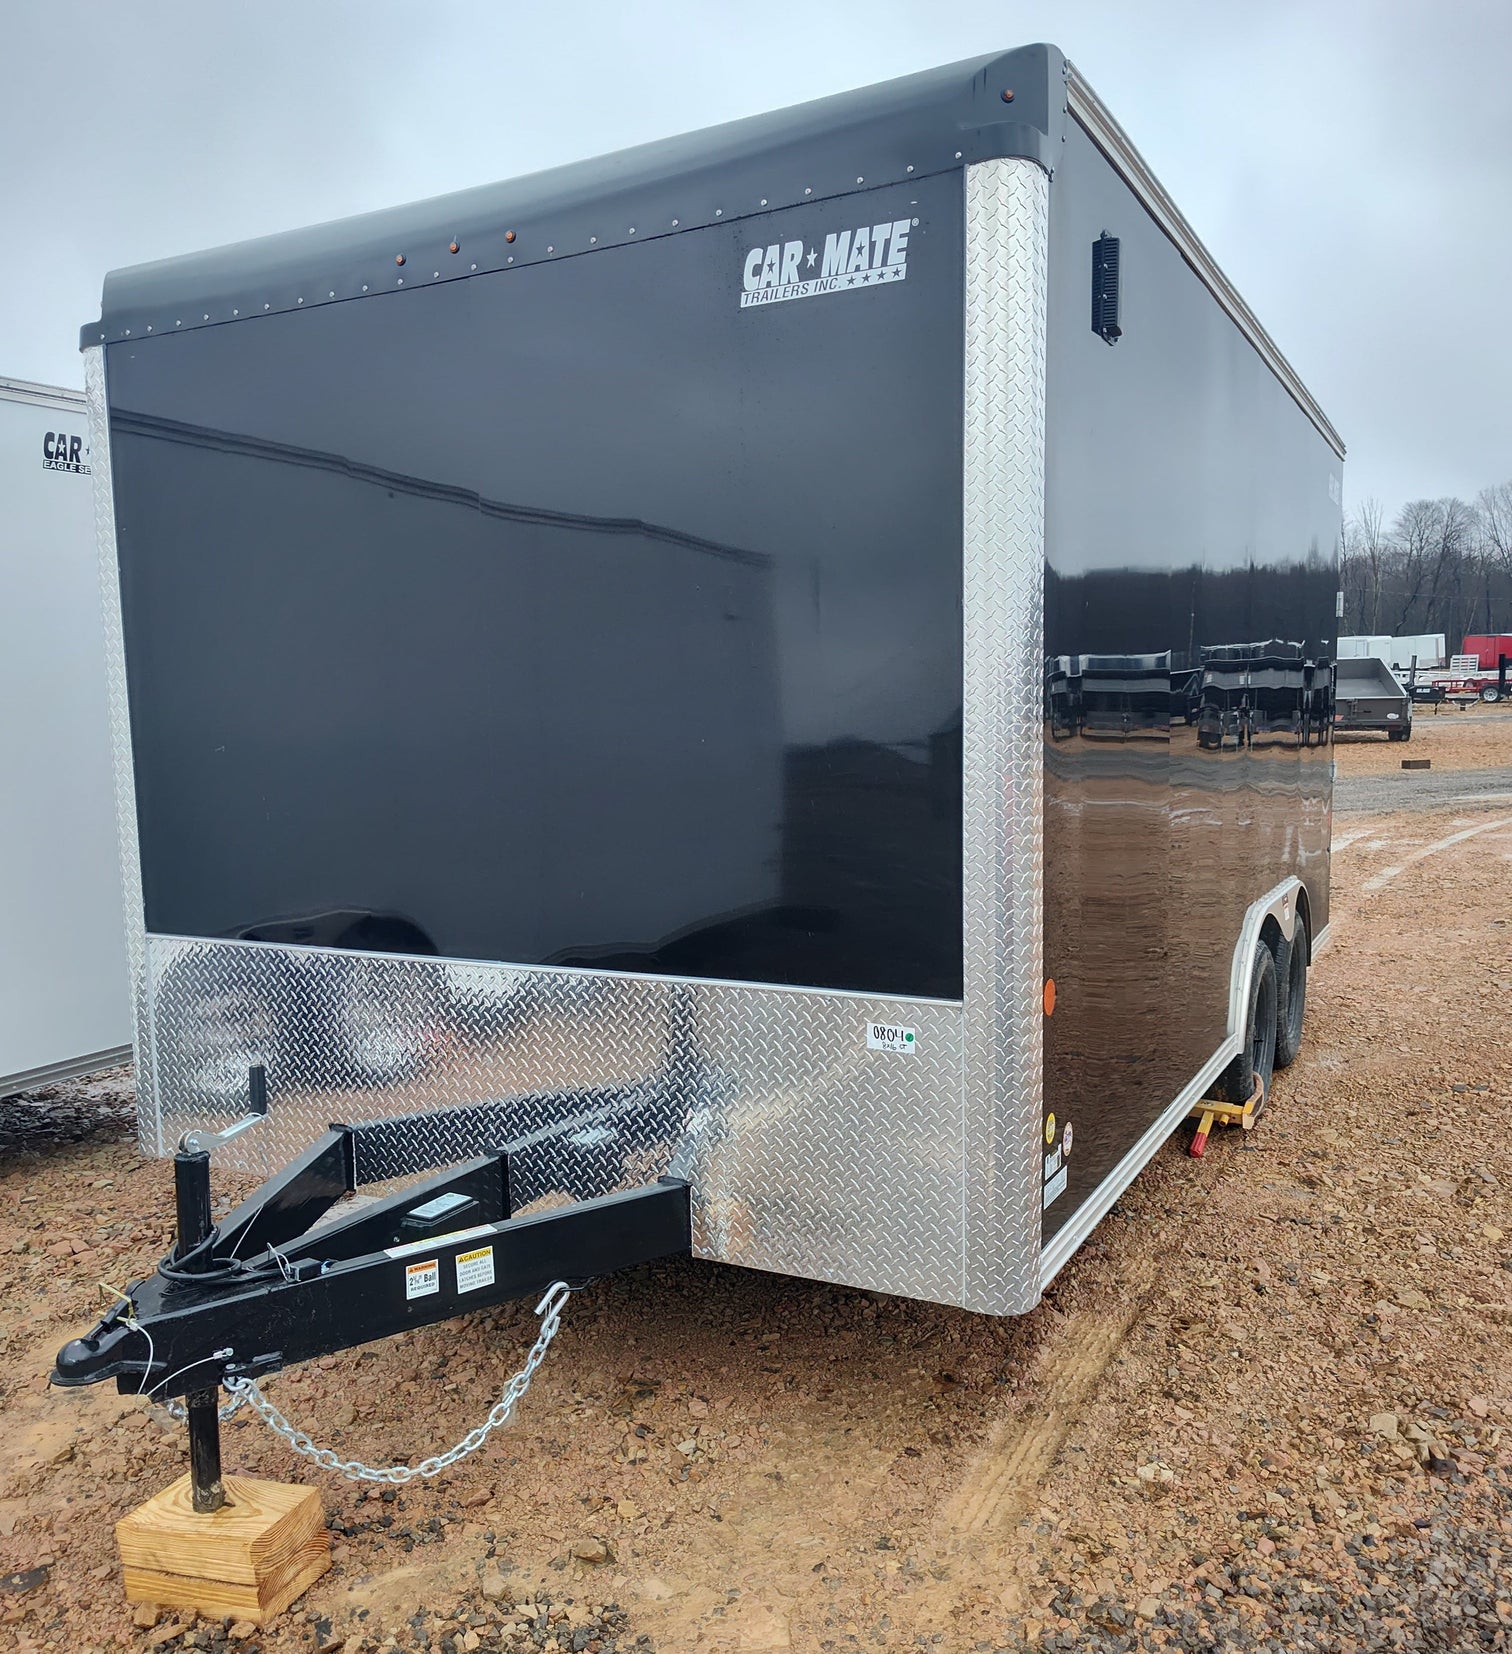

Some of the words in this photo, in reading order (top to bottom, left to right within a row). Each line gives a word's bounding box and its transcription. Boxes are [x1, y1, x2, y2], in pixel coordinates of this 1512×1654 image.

[744, 240, 804, 291] CAR
[821, 219, 911, 277] MATE
[744, 282, 809, 305] TRAILERS
[814, 278, 842, 293] INC.
[44, 431, 82, 463] CAR
[43, 460, 76, 472] EAGLE
[873, 1026, 904, 1042] 0804
[464, 1249, 491, 1262] CAUTION
[424, 1271, 437, 1282] Ball
